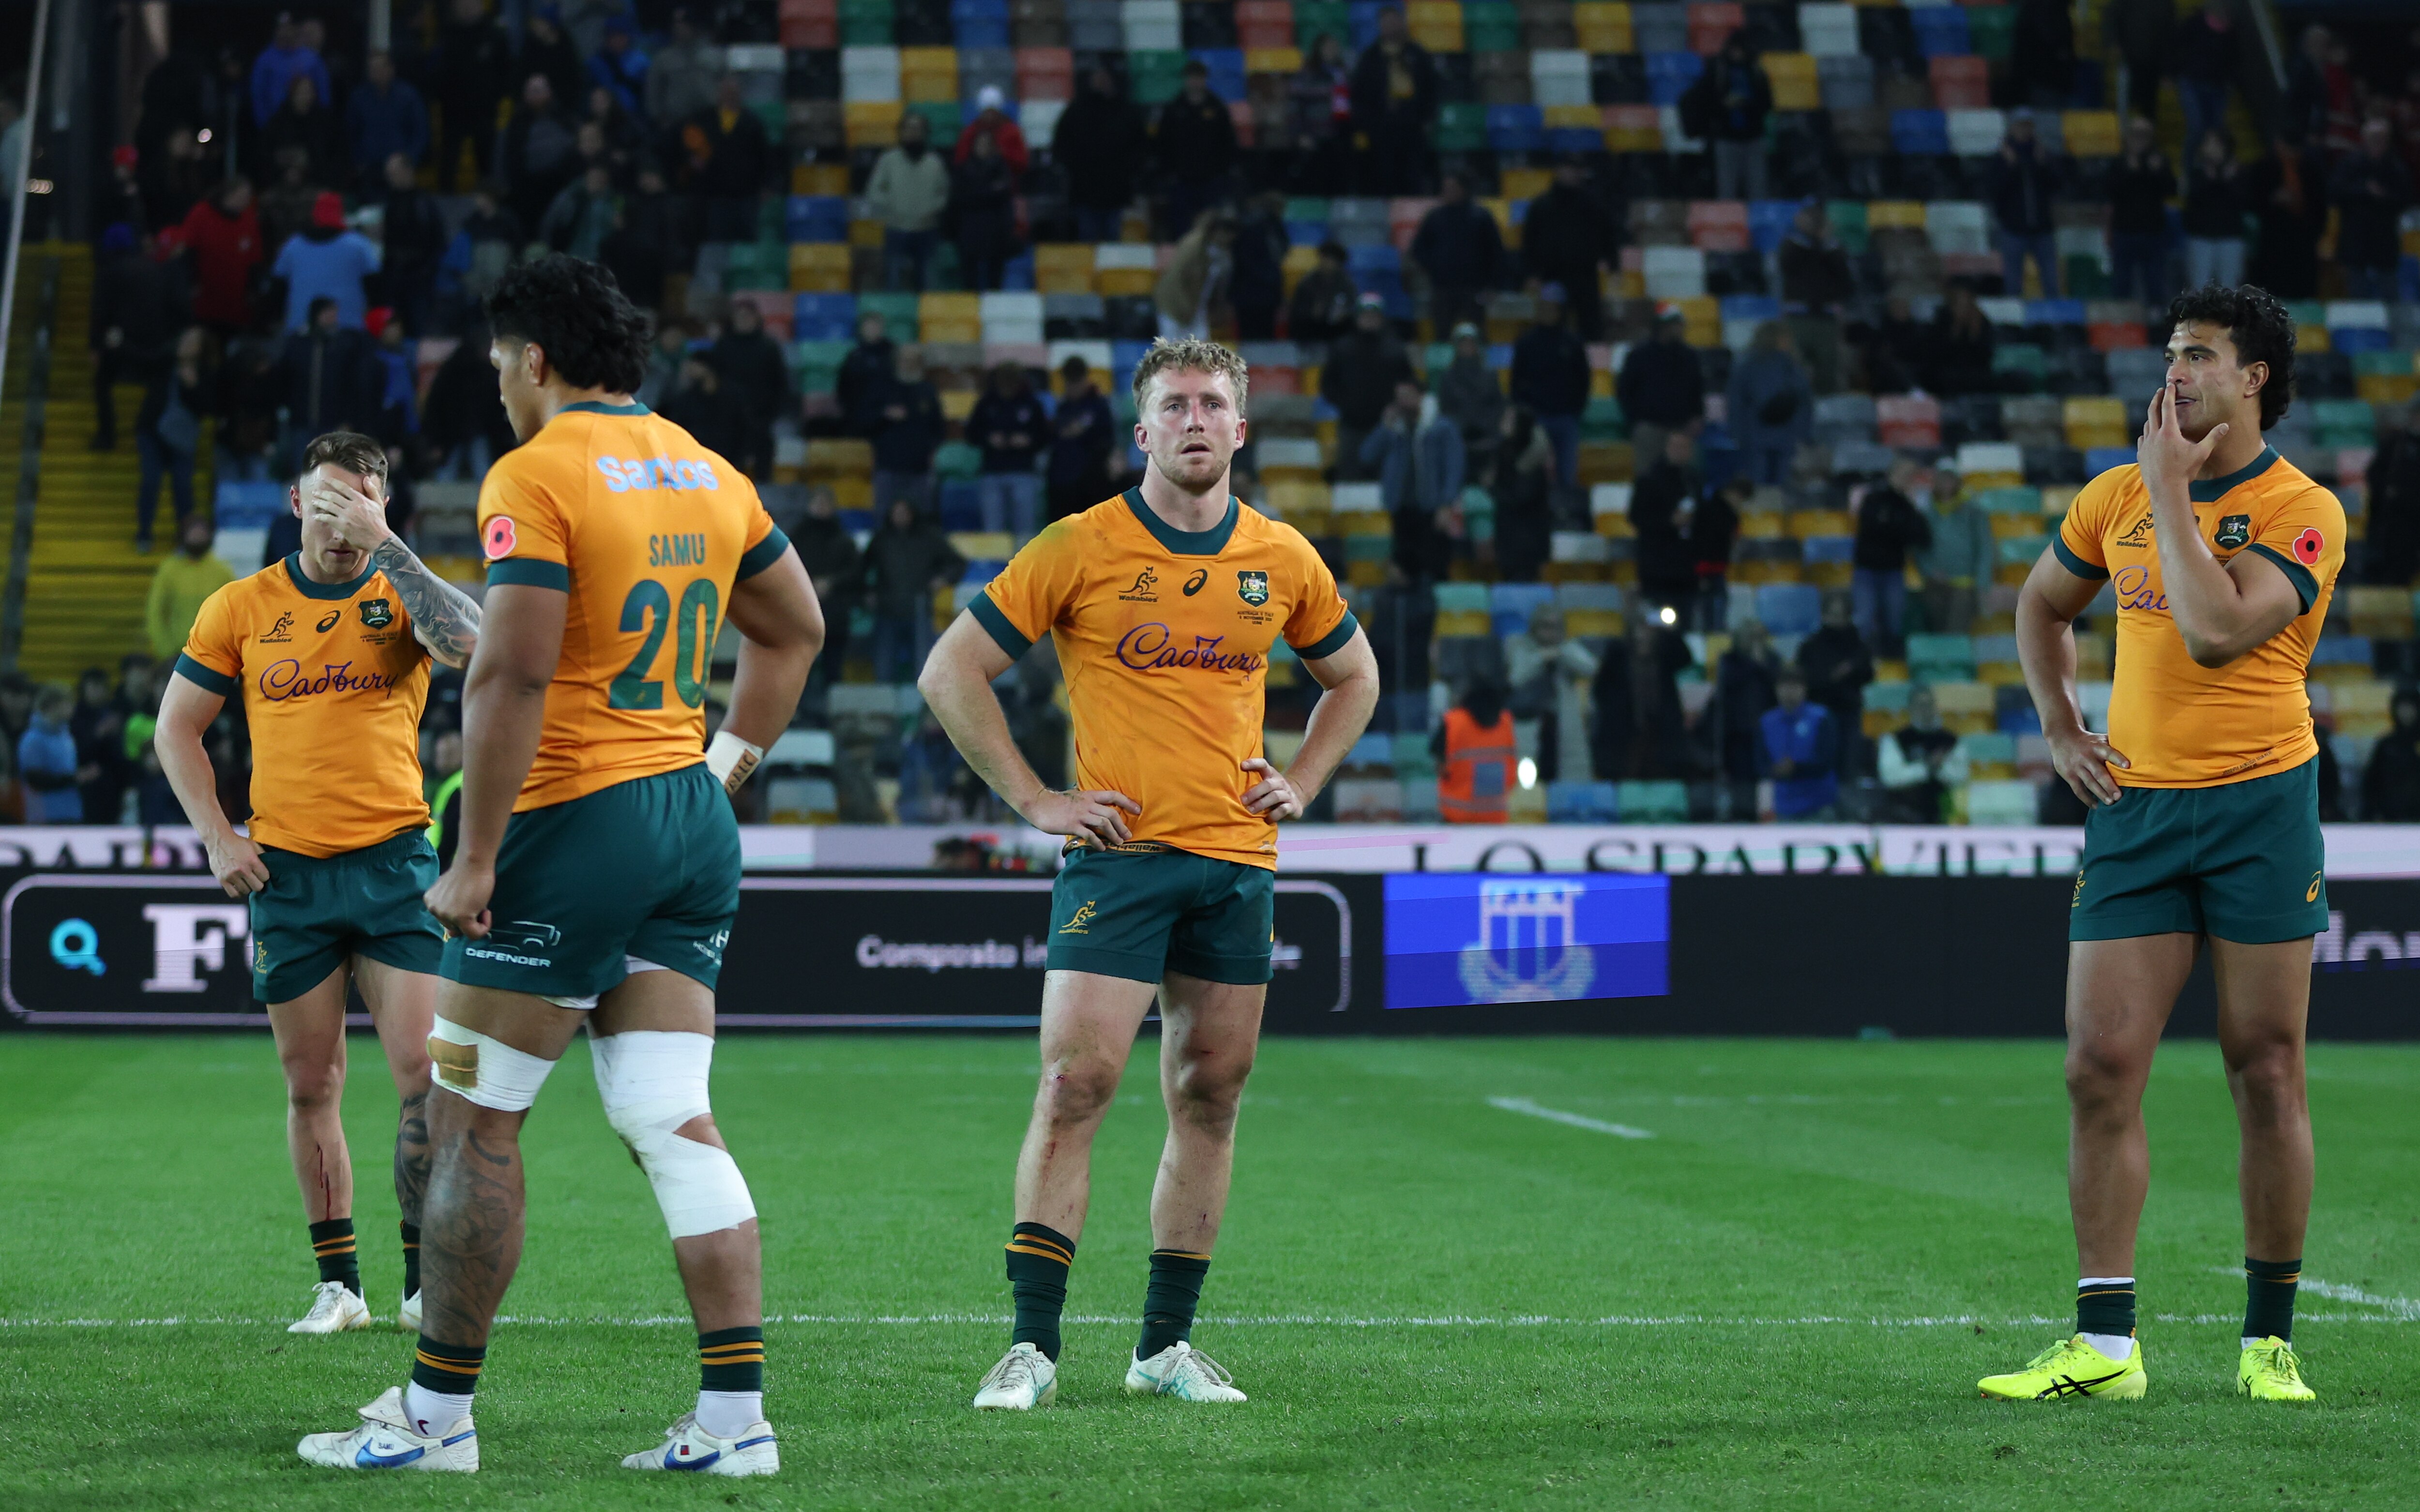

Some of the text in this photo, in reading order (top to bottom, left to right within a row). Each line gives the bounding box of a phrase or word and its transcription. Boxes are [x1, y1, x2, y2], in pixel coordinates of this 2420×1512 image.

[596, 453, 719, 493] Santos
[649, 533, 705, 567] SAMU
[608, 579, 719, 709] 20
[1115, 622, 1262, 681] Cadbury
[259, 659, 399, 701] Cadbury
[141, 903, 254, 993] F
[465, 947, 551, 968] DEFENDER
